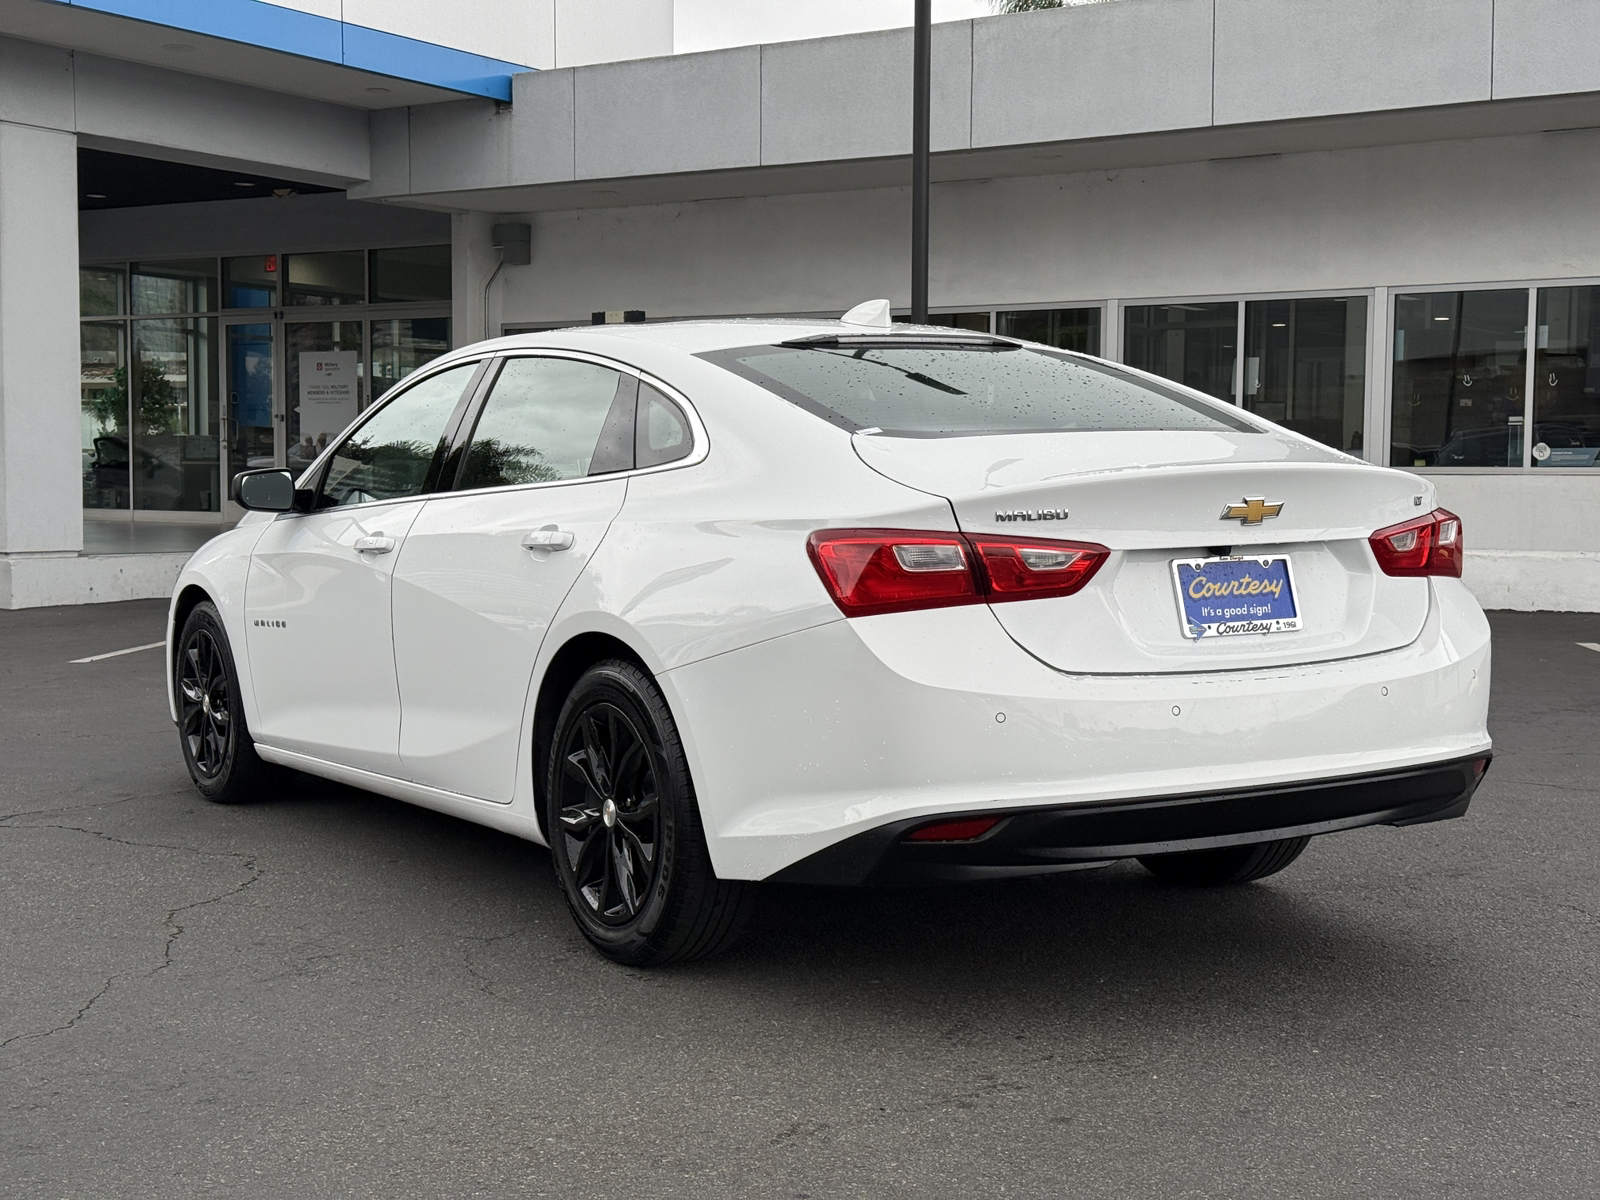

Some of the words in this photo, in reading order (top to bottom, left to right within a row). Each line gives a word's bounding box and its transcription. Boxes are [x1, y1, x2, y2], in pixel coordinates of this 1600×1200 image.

[995, 508, 1069, 522] MALIBU
[1188, 574, 1283, 599] Courtesy
[1202, 606, 1215, 617] It's
[1224, 604, 1248, 618] good
[1249, 603, 1272, 617] sign!
[1216, 619, 1273, 635] Courtesy
